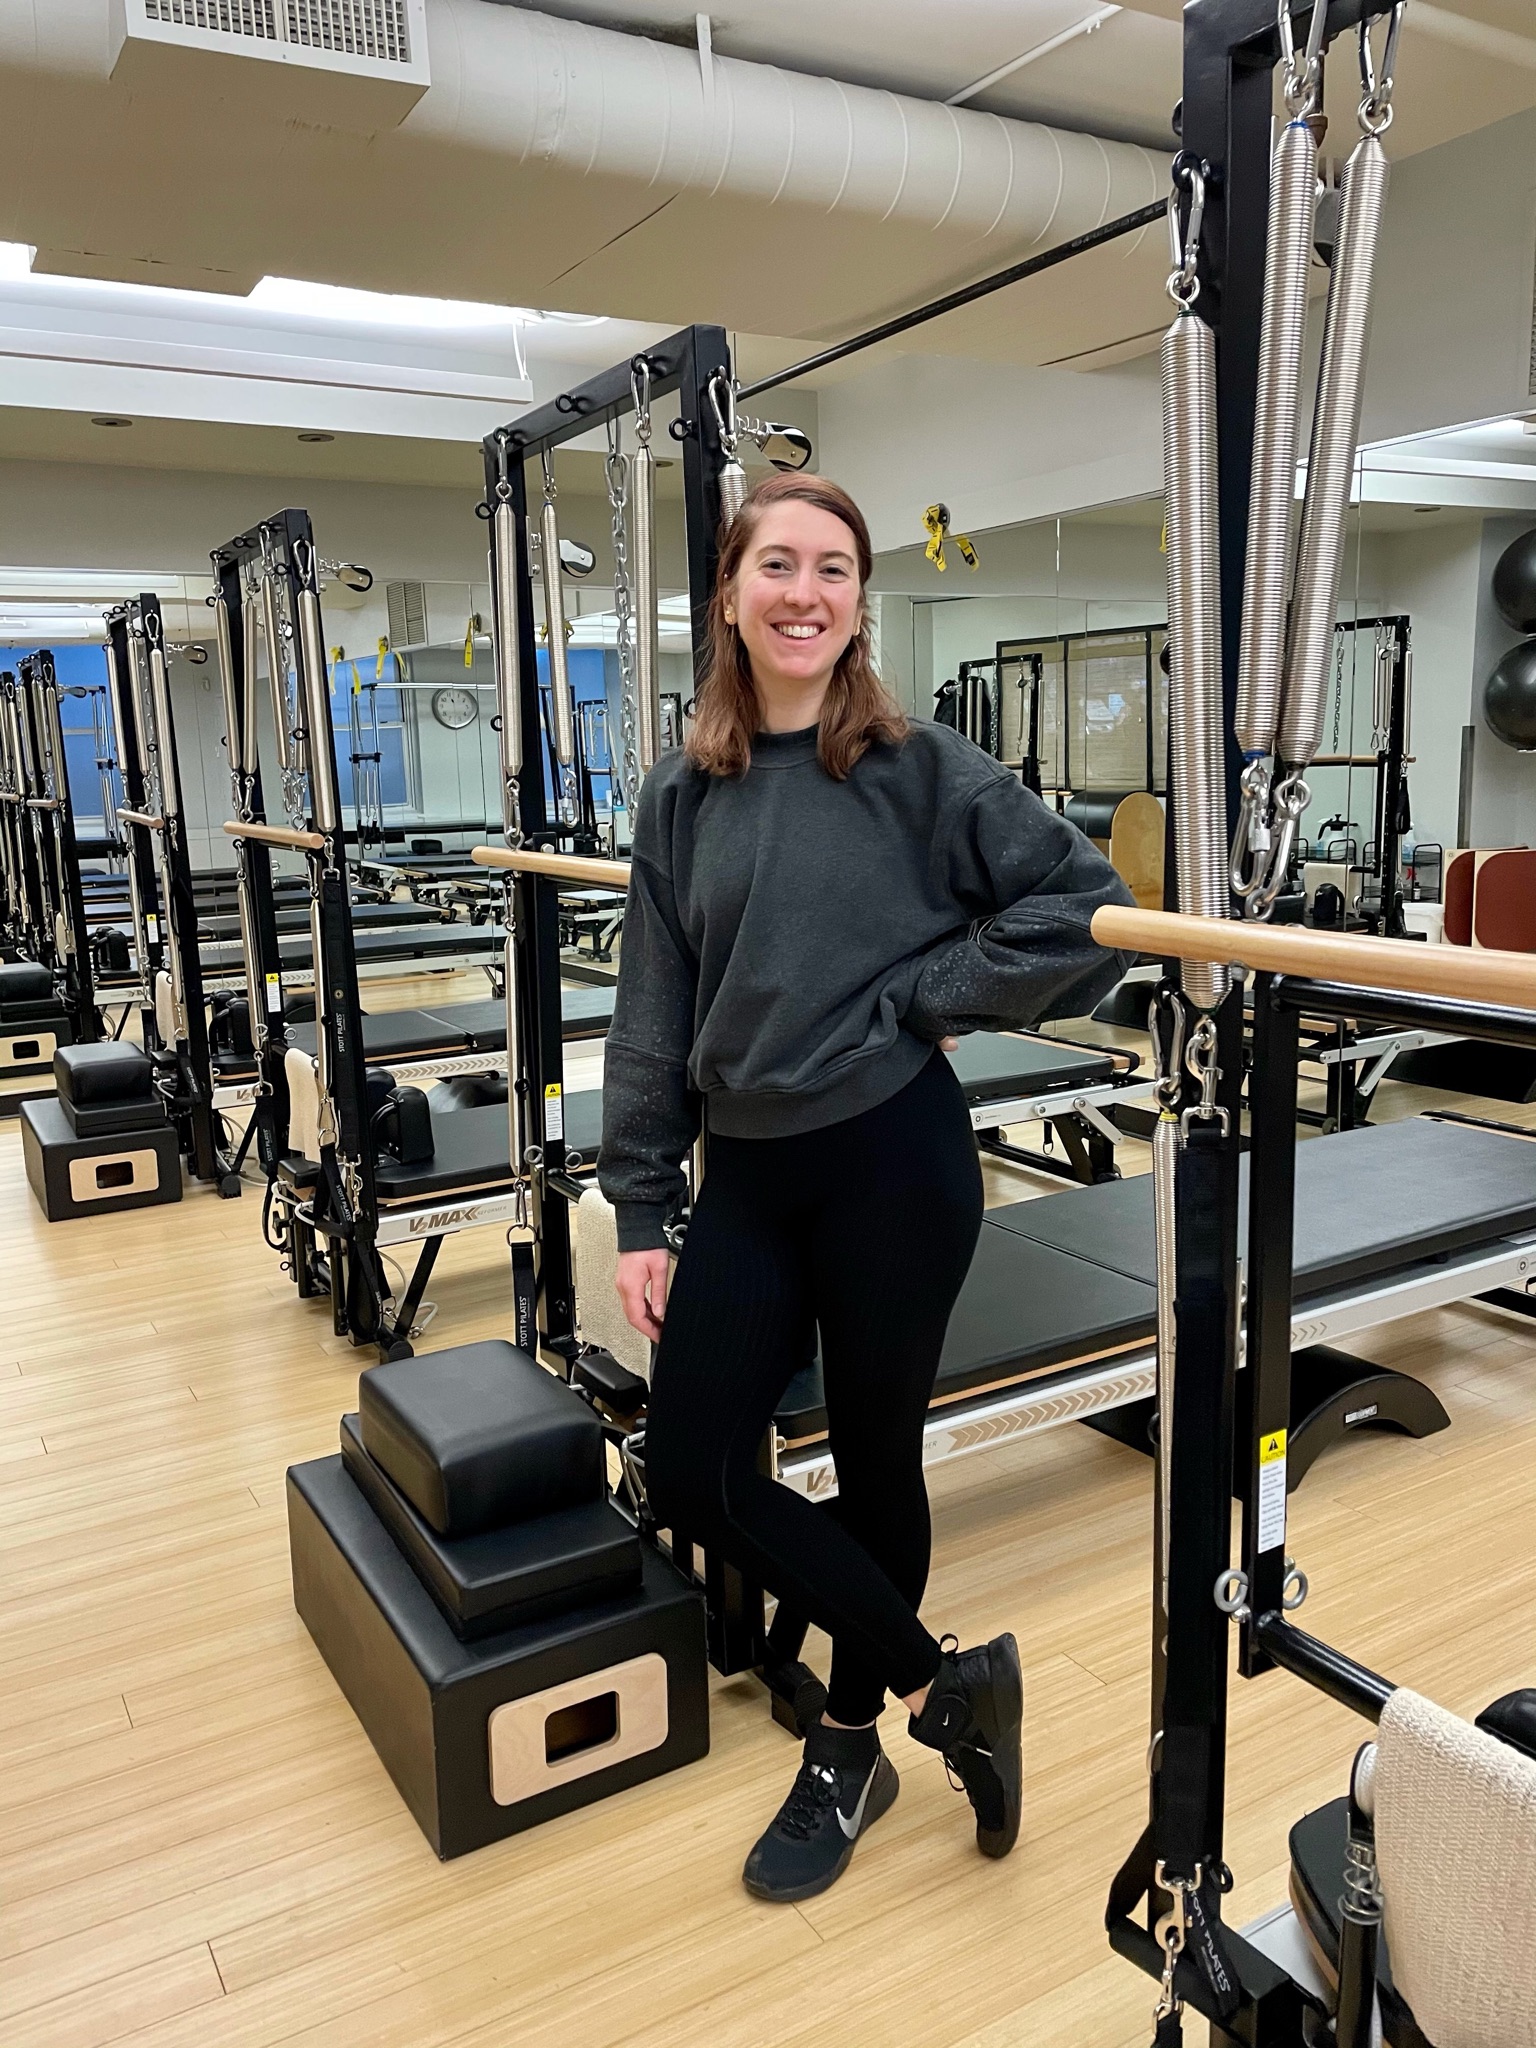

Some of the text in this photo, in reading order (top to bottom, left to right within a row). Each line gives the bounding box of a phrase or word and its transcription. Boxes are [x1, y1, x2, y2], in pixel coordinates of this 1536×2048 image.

[335, 1012, 346, 1053] STOTT PILATES
[336, 1184, 346, 1200] STOTT
[342, 1201, 353, 1222] PILATES
[519, 1295, 528, 1347] STOTT PILATES
[1261, 1450, 1286, 1464] CAUTION
